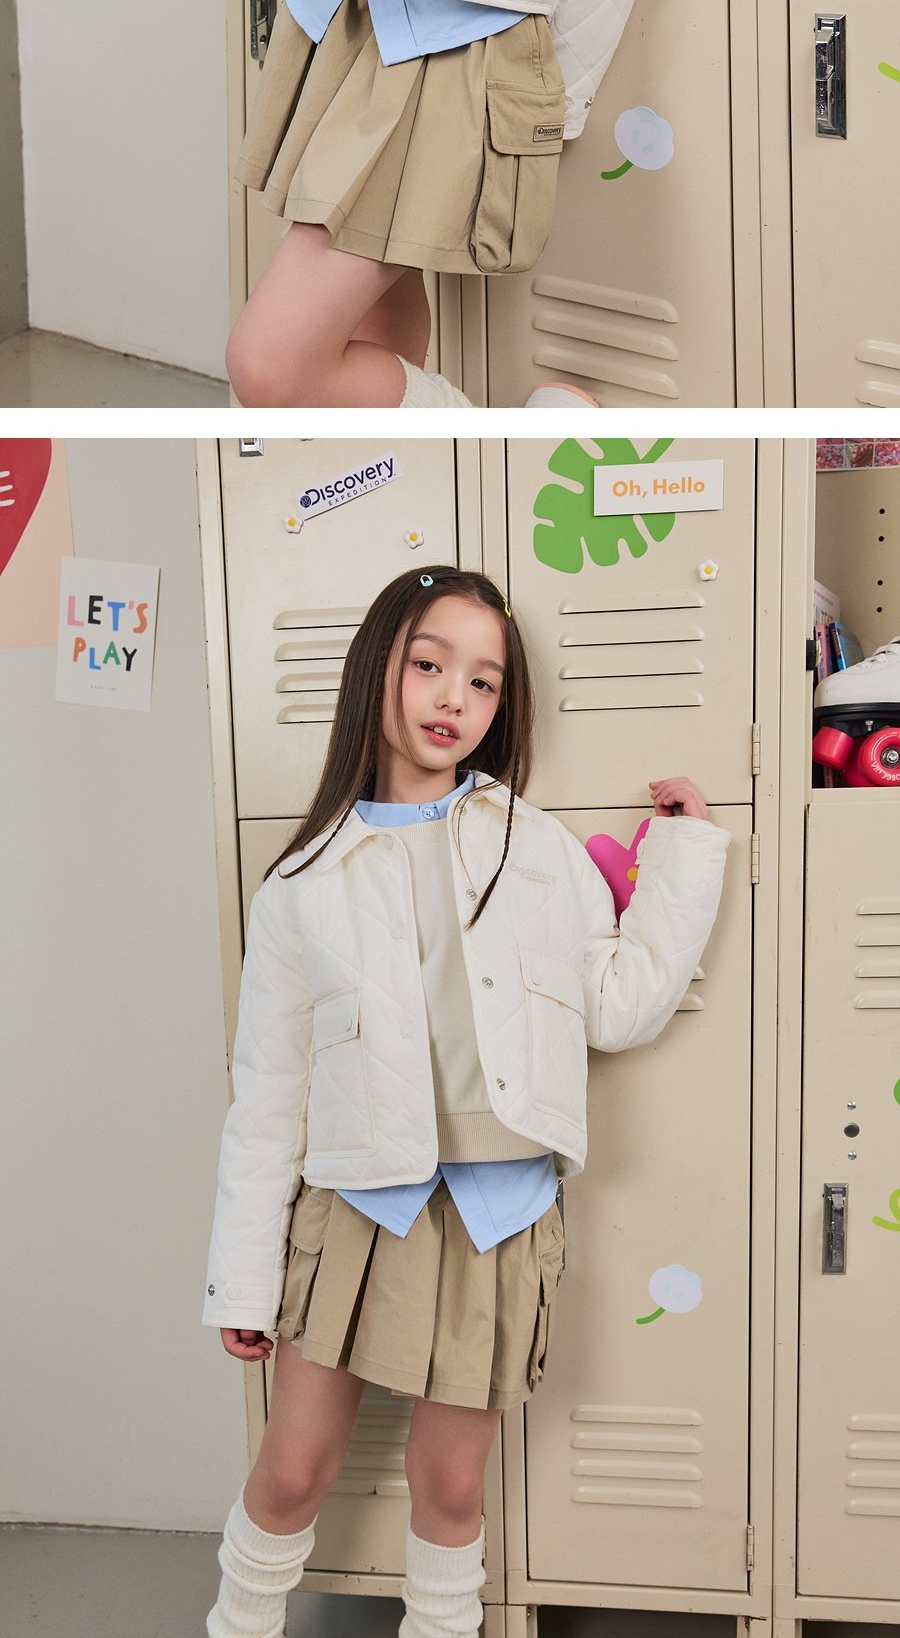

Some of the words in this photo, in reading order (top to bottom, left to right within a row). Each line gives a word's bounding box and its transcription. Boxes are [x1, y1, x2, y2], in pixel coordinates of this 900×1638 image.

[300, 457, 394, 508] Discovery
[328, 477, 387, 506] EXPEDITION
[612, 479, 649, 499] Oh,
[652, 476, 706, 496] Hello
[66, 594, 149, 634] LET'S
[72, 637, 138, 672] PLAY
